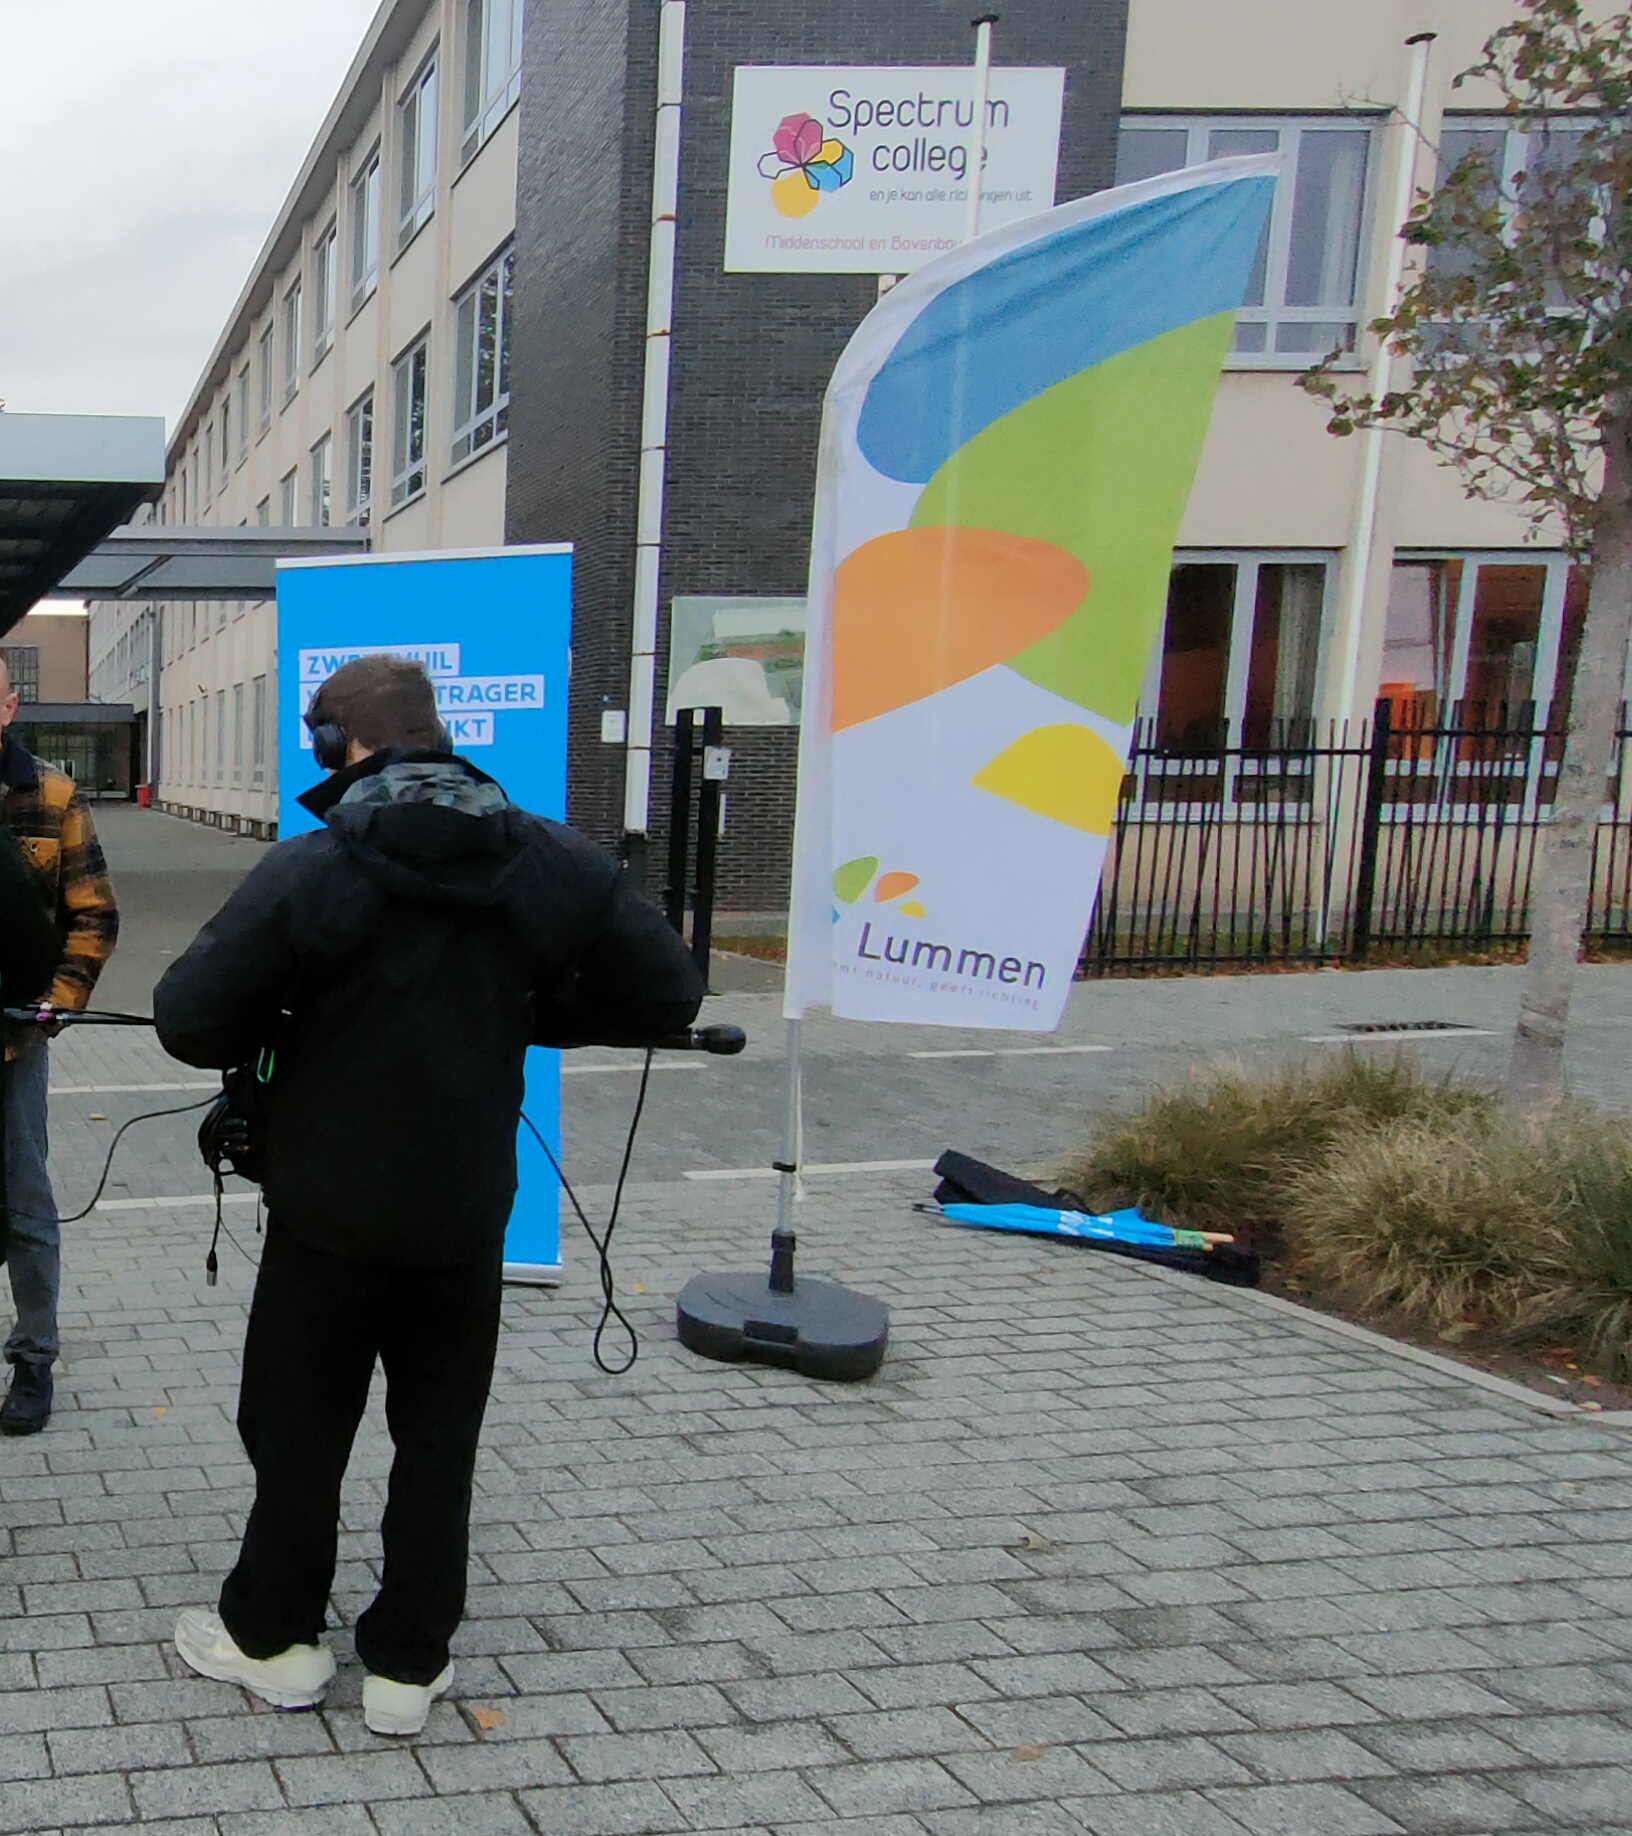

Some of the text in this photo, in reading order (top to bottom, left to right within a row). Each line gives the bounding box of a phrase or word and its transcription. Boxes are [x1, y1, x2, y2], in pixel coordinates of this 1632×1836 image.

[827, 89, 1009, 136] Spectrum
[869, 190, 885, 201] en
[885, 189, 898, 204] je
[900, 188, 923, 201] kan
[925, 188, 946, 201] alle
[1015, 189, 1032, 201] uit
[765, 234, 864, 250] Middenschool
[869, 238, 886, 250] en
[857, 922, 1046, 990] Lummen
